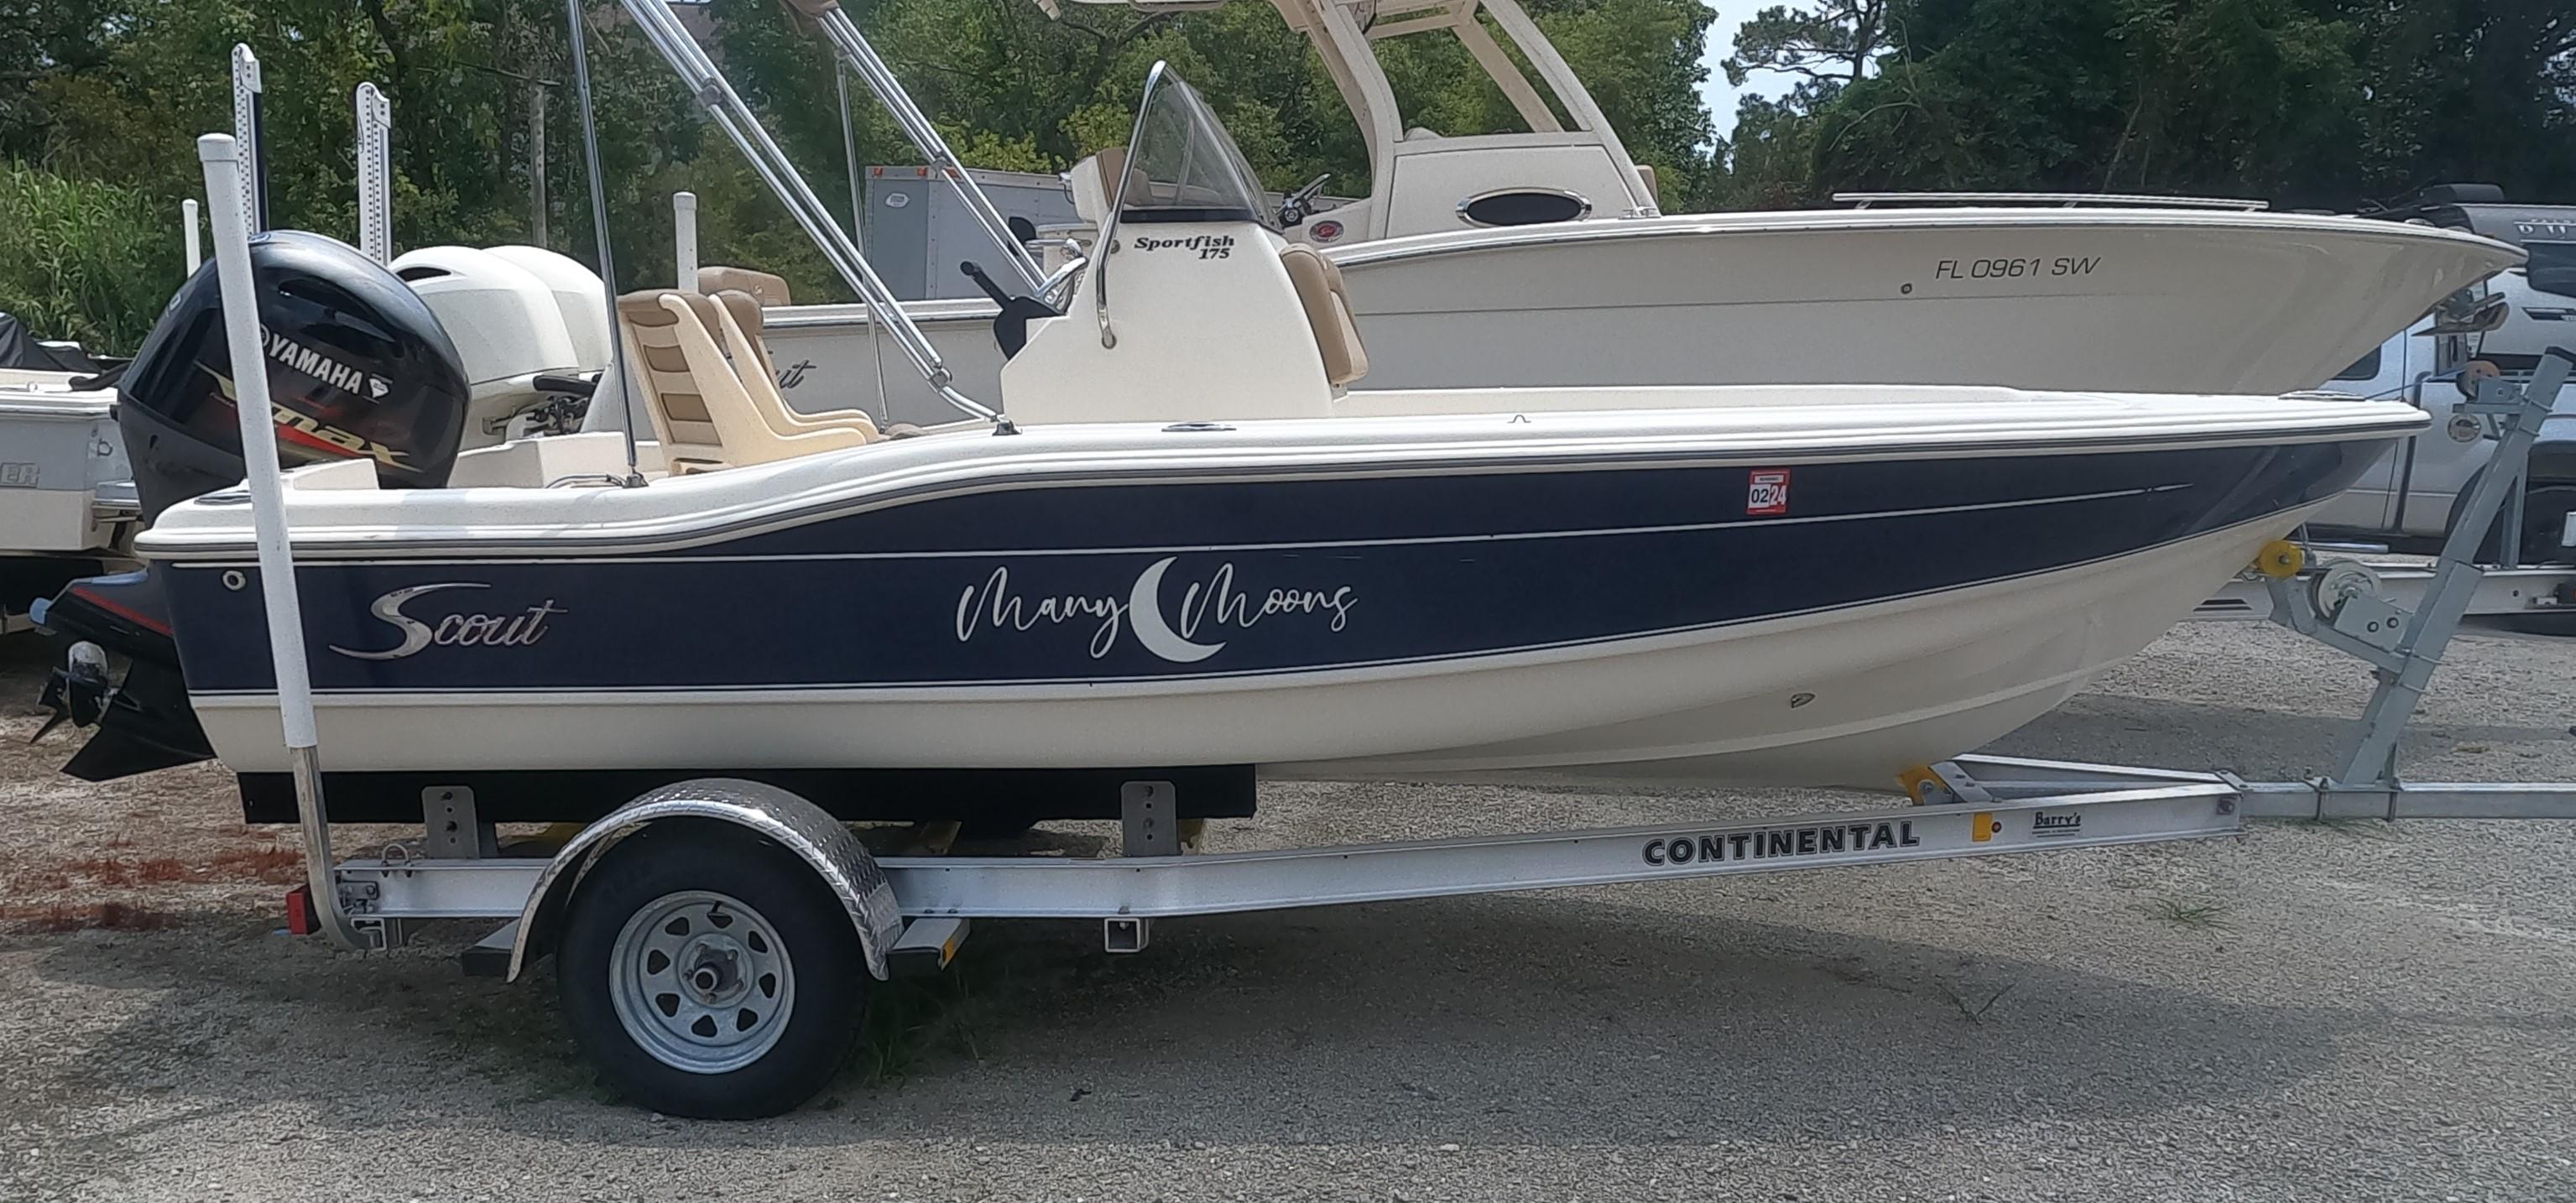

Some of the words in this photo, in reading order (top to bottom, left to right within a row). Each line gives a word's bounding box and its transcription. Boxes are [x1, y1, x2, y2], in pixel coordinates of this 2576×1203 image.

[1134, 235, 1235, 251] Sportfish
[1198, 247, 1231, 260] 175
[1935, 259, 1964, 280] FL
[1970, 258, 2042, 279] 0961
[2051, 256, 2102, 276] SW
[269, 332, 363, 395] YAMAHA
[328, 581, 569, 660] Scout
[957, 565, 1129, 659] Many
[1180, 562, 1358, 640] Moons
[2035, 811, 2081, 825] Barry's
[1641, 820, 1921, 867] CONTINENTAL
